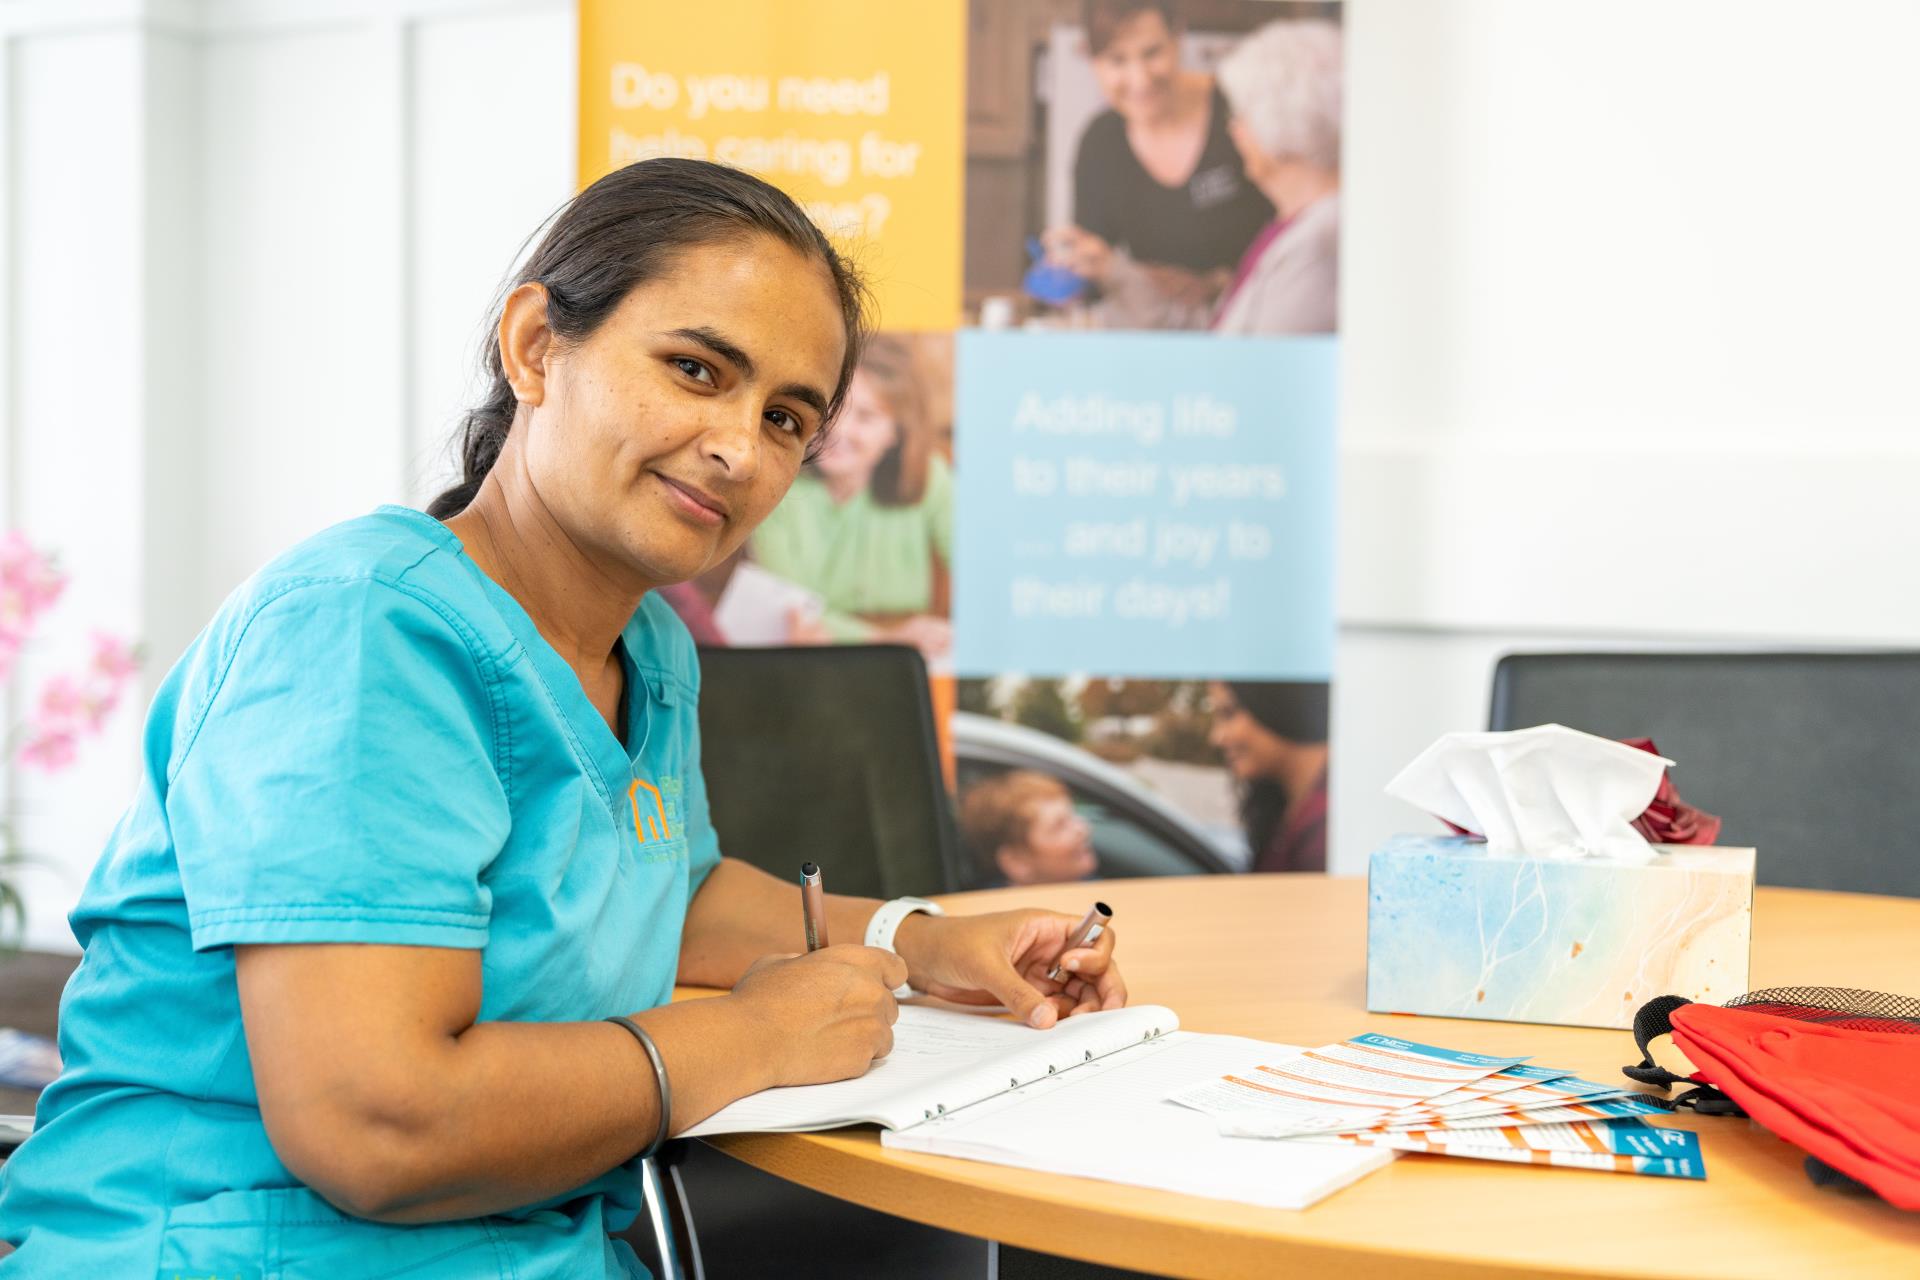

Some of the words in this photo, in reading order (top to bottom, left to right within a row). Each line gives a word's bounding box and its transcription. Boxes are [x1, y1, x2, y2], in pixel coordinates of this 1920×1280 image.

[611, 62, 678, 109] Do
[687, 74, 770, 119] you
[777, 70, 890, 115] need
[859, 131, 921, 178] for
[1014, 390, 1164, 447] Adding
[1173, 391, 1237, 437] life
[1013, 454, 1057, 495] to
[1065, 455, 1160, 495] their
[1168, 464, 1285, 507] years
[1064, 518, 1146, 557] and
[1154, 514, 1219, 567] joy
[1228, 516, 1271, 559] to
[1012, 577, 1105, 617] their
[1114, 576, 1231, 628] days!
